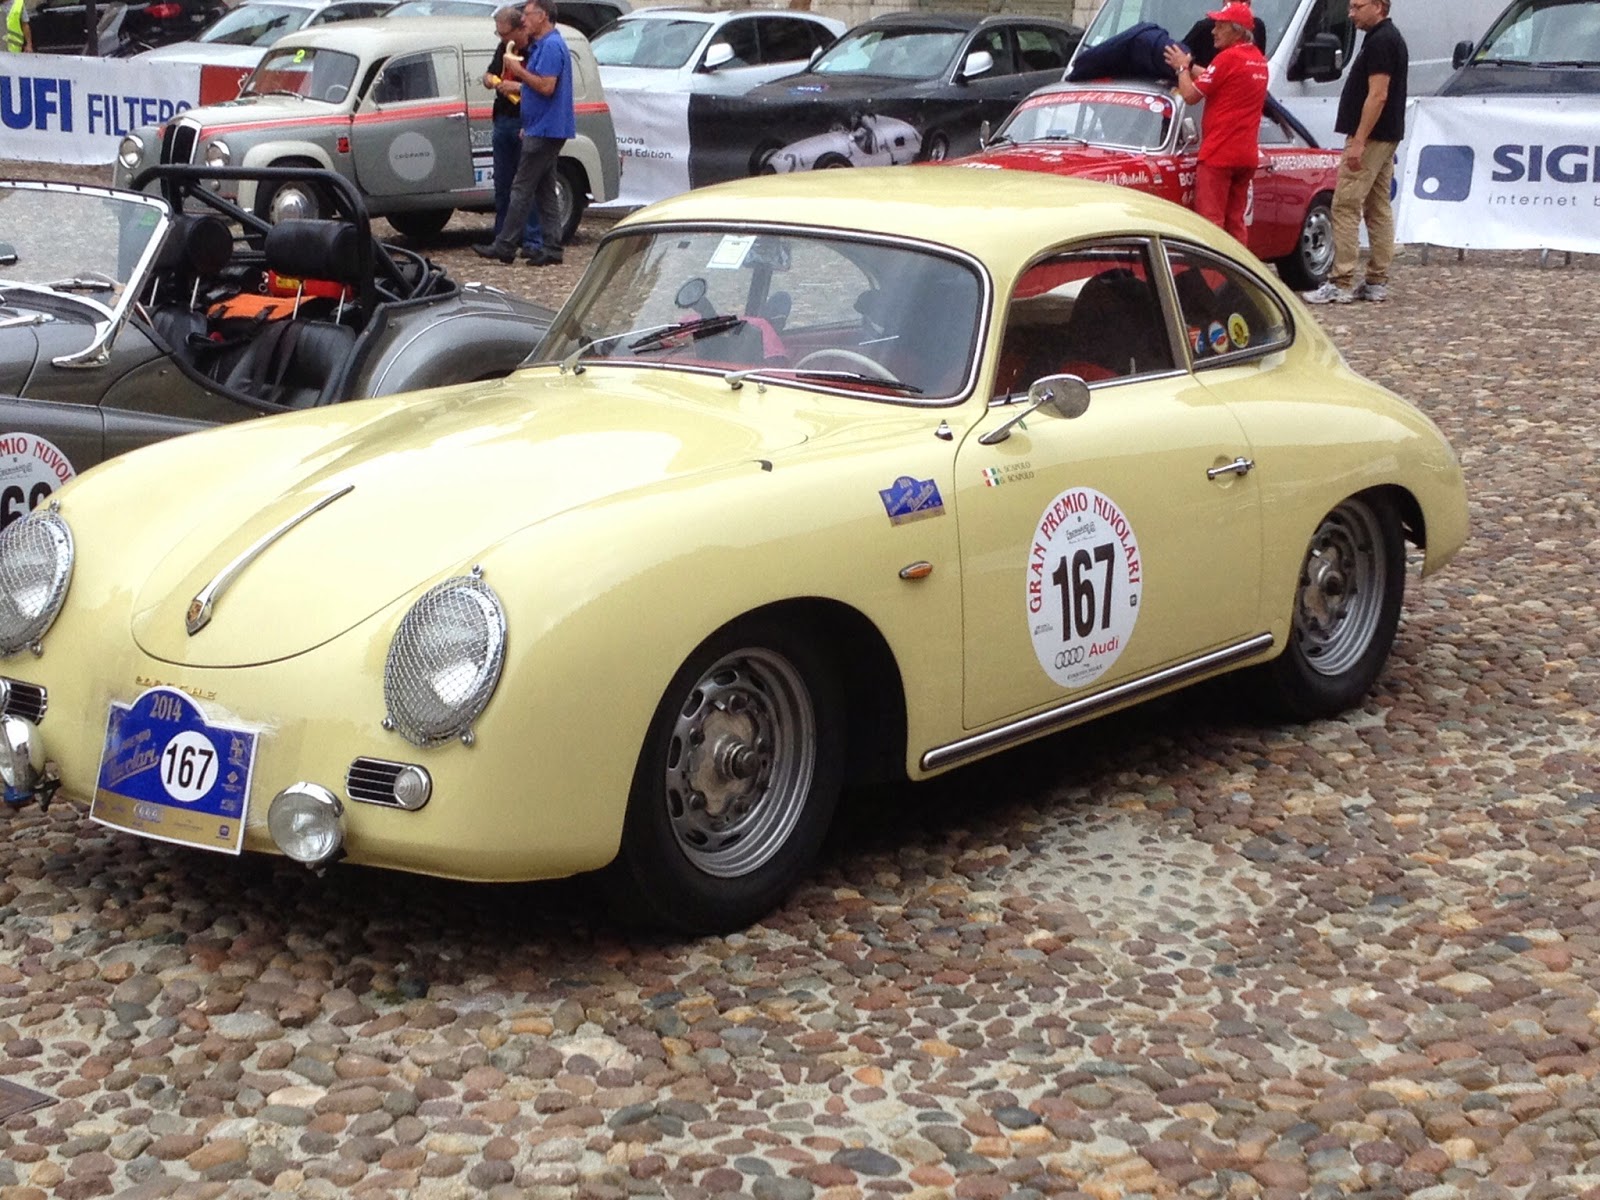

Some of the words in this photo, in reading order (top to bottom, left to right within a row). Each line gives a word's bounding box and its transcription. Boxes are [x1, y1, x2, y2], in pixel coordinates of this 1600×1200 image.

[293, 49, 306, 63] 2
[0, 76, 73, 133] UFI
[87, 93, 192, 137] FILTE
[635, 148, 674, 159] Edition.
[1488, 193, 1577, 206] internet
[1029, 542, 1047, 614] GRAN
[1041, 492, 1088, 541] PREMIO
[1093, 495, 1140, 584] NUVOLARI
[1052, 542, 1115, 642] 167
[1088, 635, 1120, 658] Audi
[150, 693, 182, 722] 2014
[165, 743, 214, 791] 167
